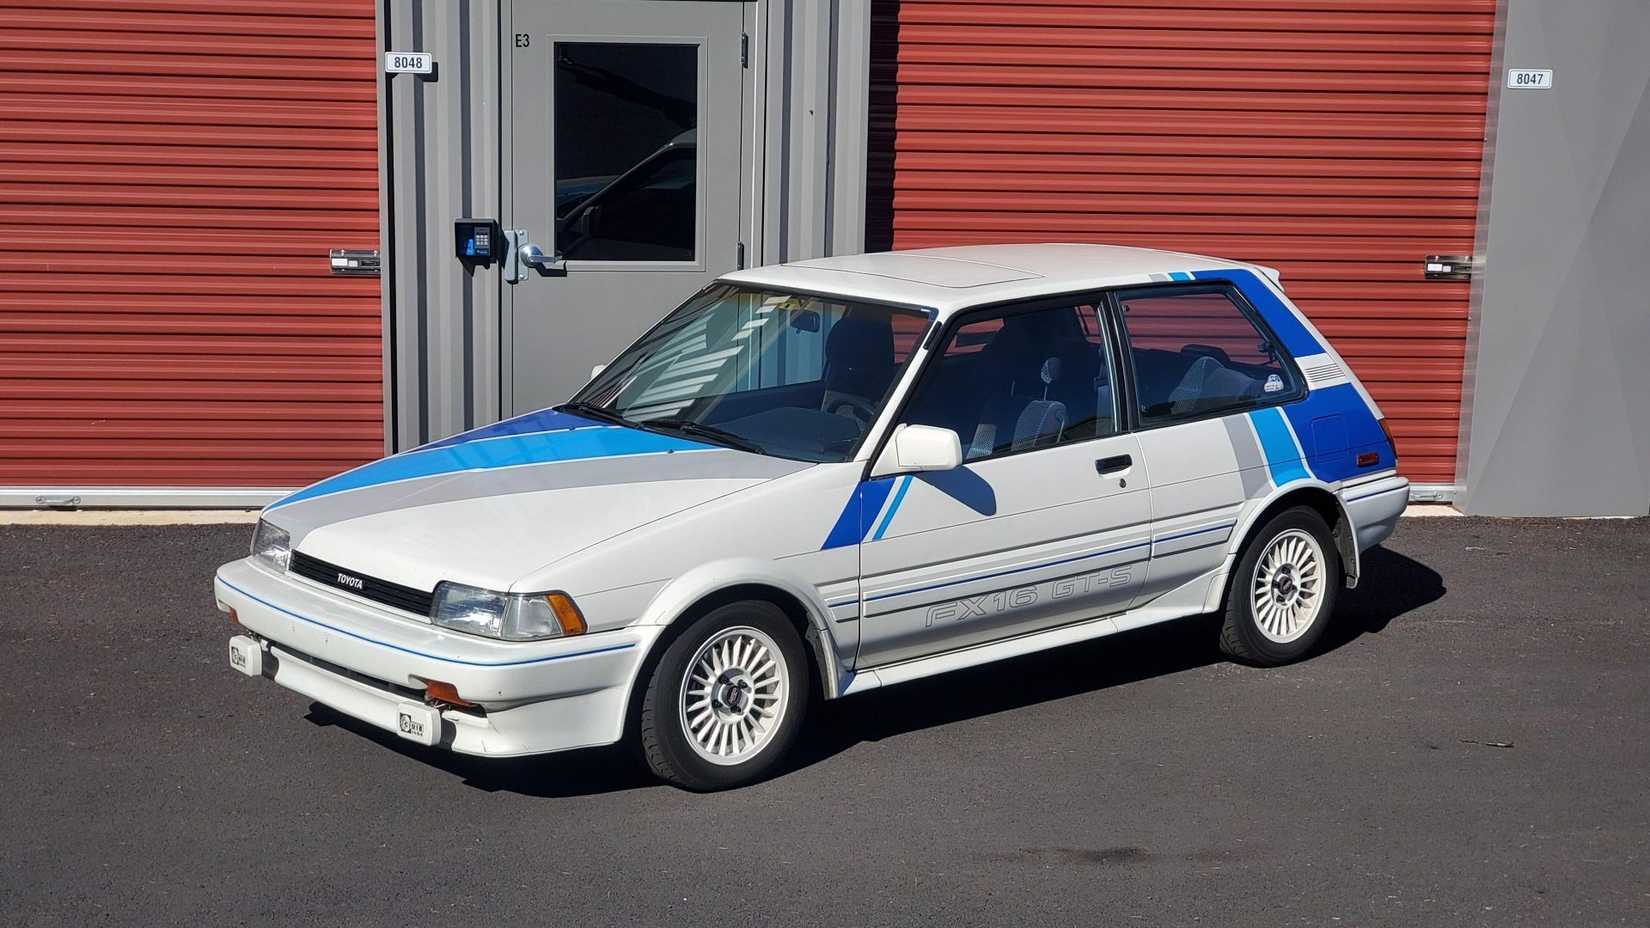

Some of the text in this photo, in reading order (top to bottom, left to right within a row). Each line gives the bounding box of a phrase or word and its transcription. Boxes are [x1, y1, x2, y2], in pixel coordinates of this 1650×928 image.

[515, 33, 530, 48] E3
[394, 56, 422, 69] 8048
[1516, 73, 1544, 85] 8047
[337, 573, 363, 590] TOYOTA
[925, 566, 1132, 628] FX16 GT-S
